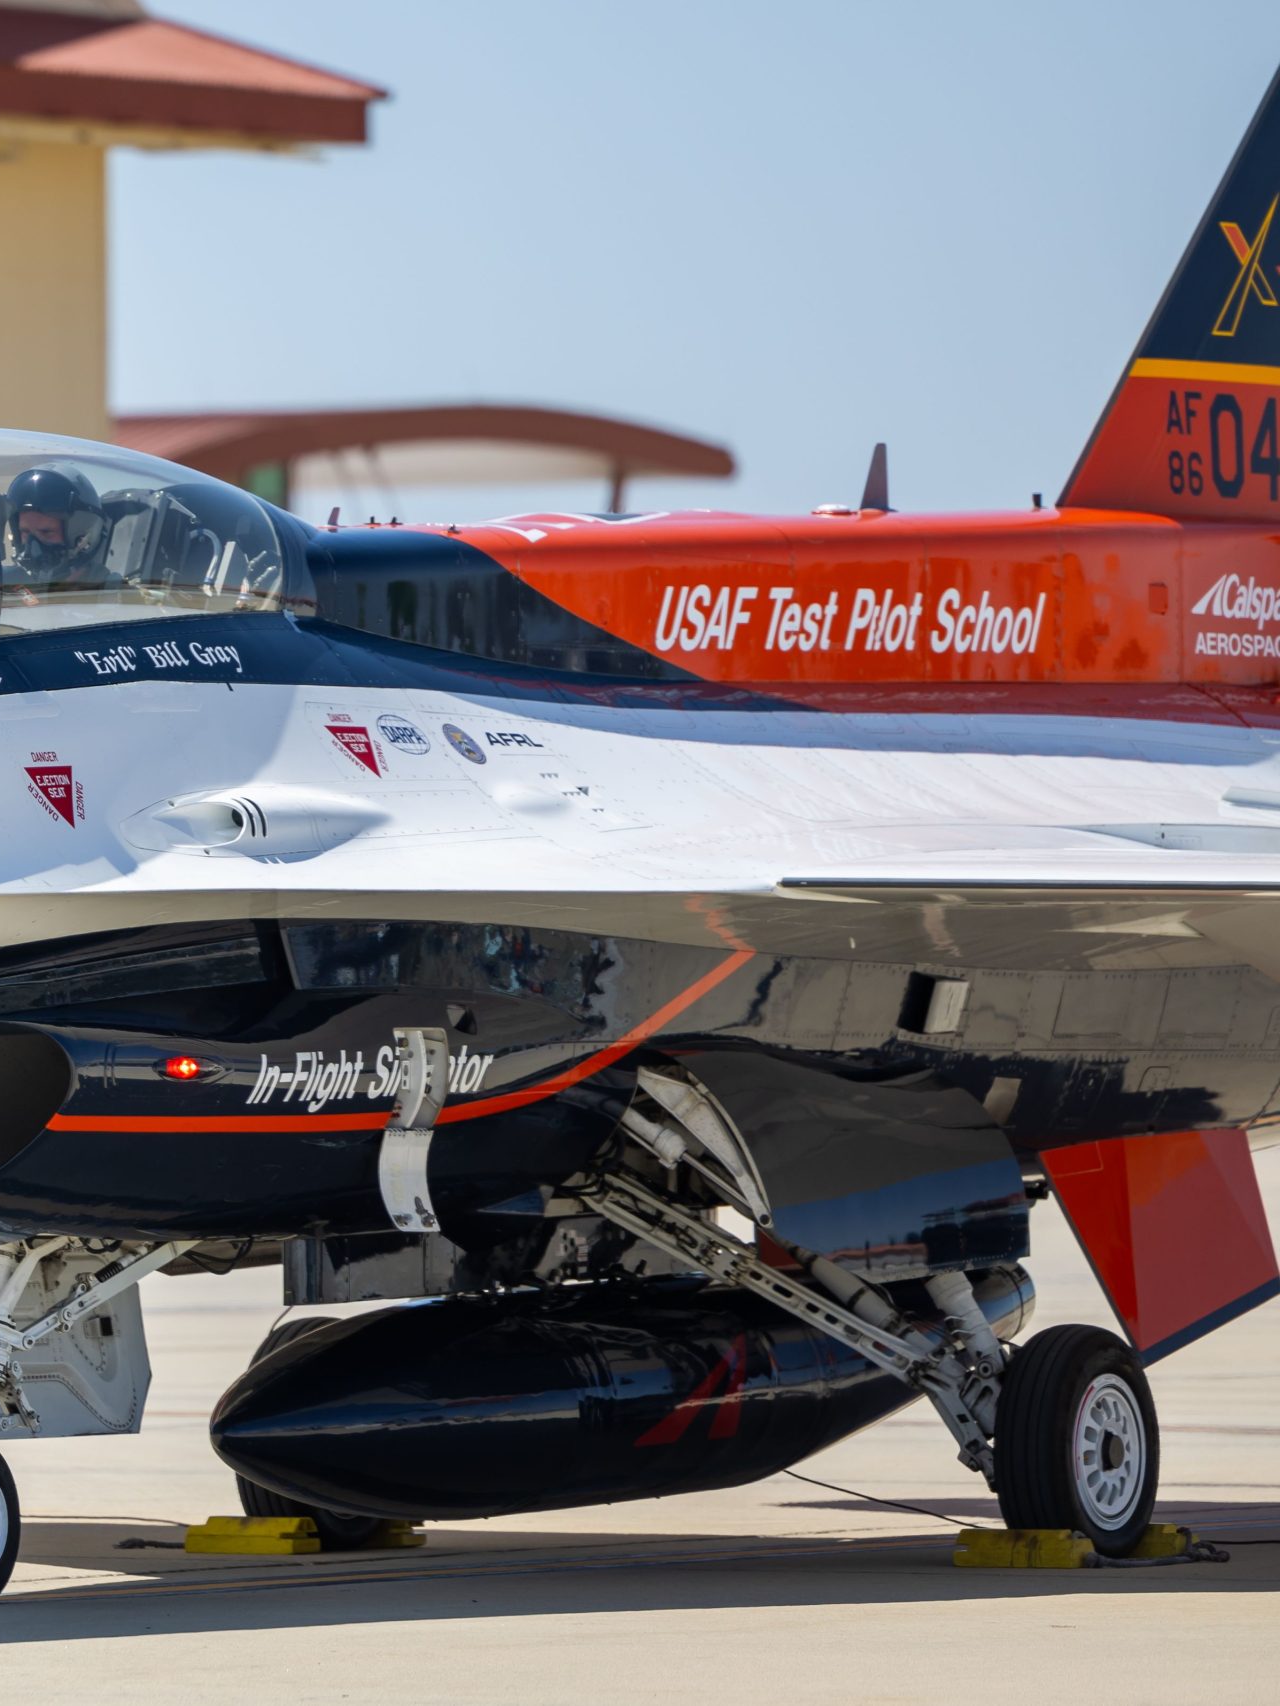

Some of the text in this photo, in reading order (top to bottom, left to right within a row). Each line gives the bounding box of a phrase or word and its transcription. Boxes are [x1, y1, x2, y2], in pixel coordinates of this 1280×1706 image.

[1166, 390, 1202, 435] AF
[1168, 450, 1204, 496] 86
[655, 584, 1047, 655] USAF Test Pilot School
[73, 641, 243, 675] "Evil" Bill Gray
[380, 725, 427, 744] DARPA
[485, 731, 544, 748] AFRL
[35, 774, 71, 786] EJECTION
[48, 787, 67, 798] SEAT
[27, 782, 59, 822] DANGER
[75, 780, 86, 821] DANGER
[246, 1044, 495, 1113] In-Flight Sitor
